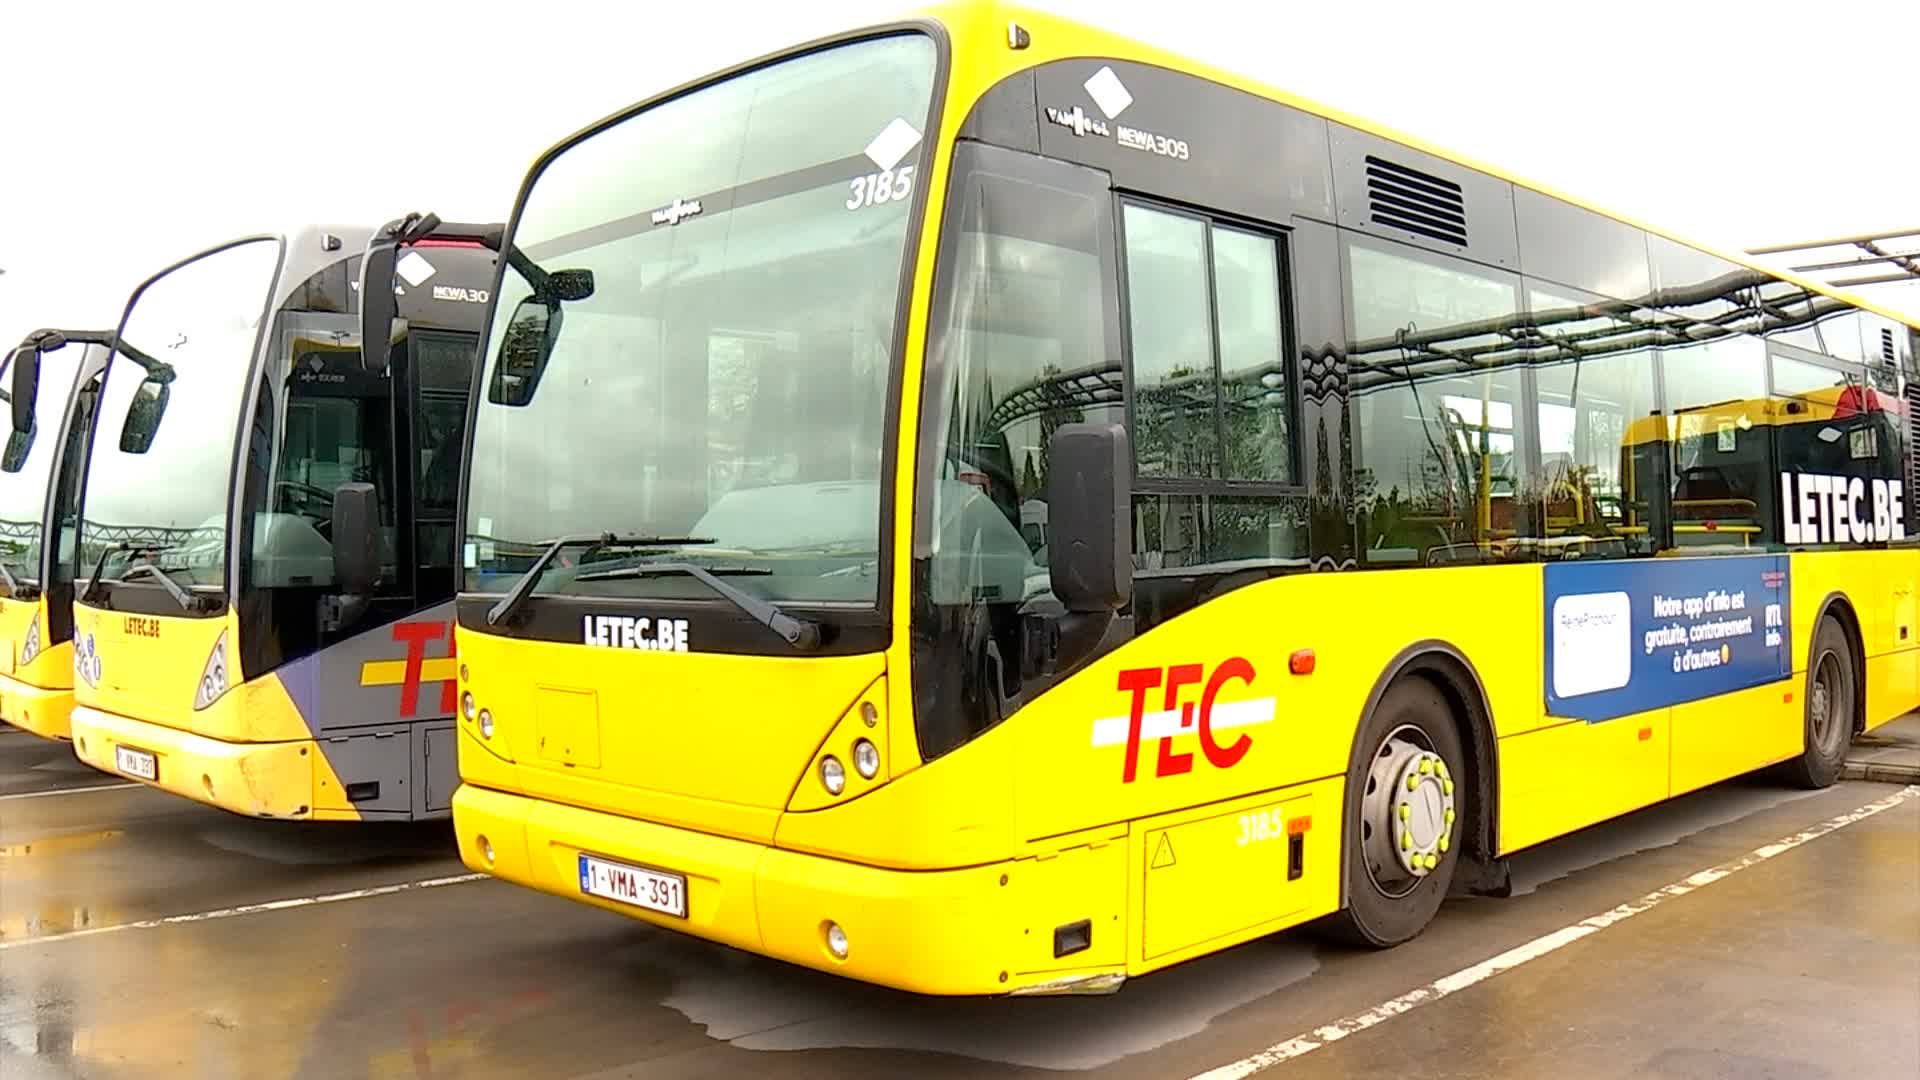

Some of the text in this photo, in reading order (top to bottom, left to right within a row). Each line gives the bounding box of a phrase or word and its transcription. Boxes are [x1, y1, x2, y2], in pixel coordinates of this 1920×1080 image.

[846, 165, 914, 210] 3185
[1781, 471, 1905, 545] LETEC.BE
[1653, 589, 1745, 619] Notre app d'info est
[1765, 604, 1782, 627] RTL
[124, 615, 160, 638] LETEC.BE
[583, 614, 689, 653] LETEC.BE
[1645, 615, 1752, 655] gratuite, contrairement
[1682, 648, 1721, 671] d'autres
[1117, 656, 1257, 784] TEC
[1236, 807, 1283, 846] 3185
[590, 864, 679, 909] 1-VMA-391
